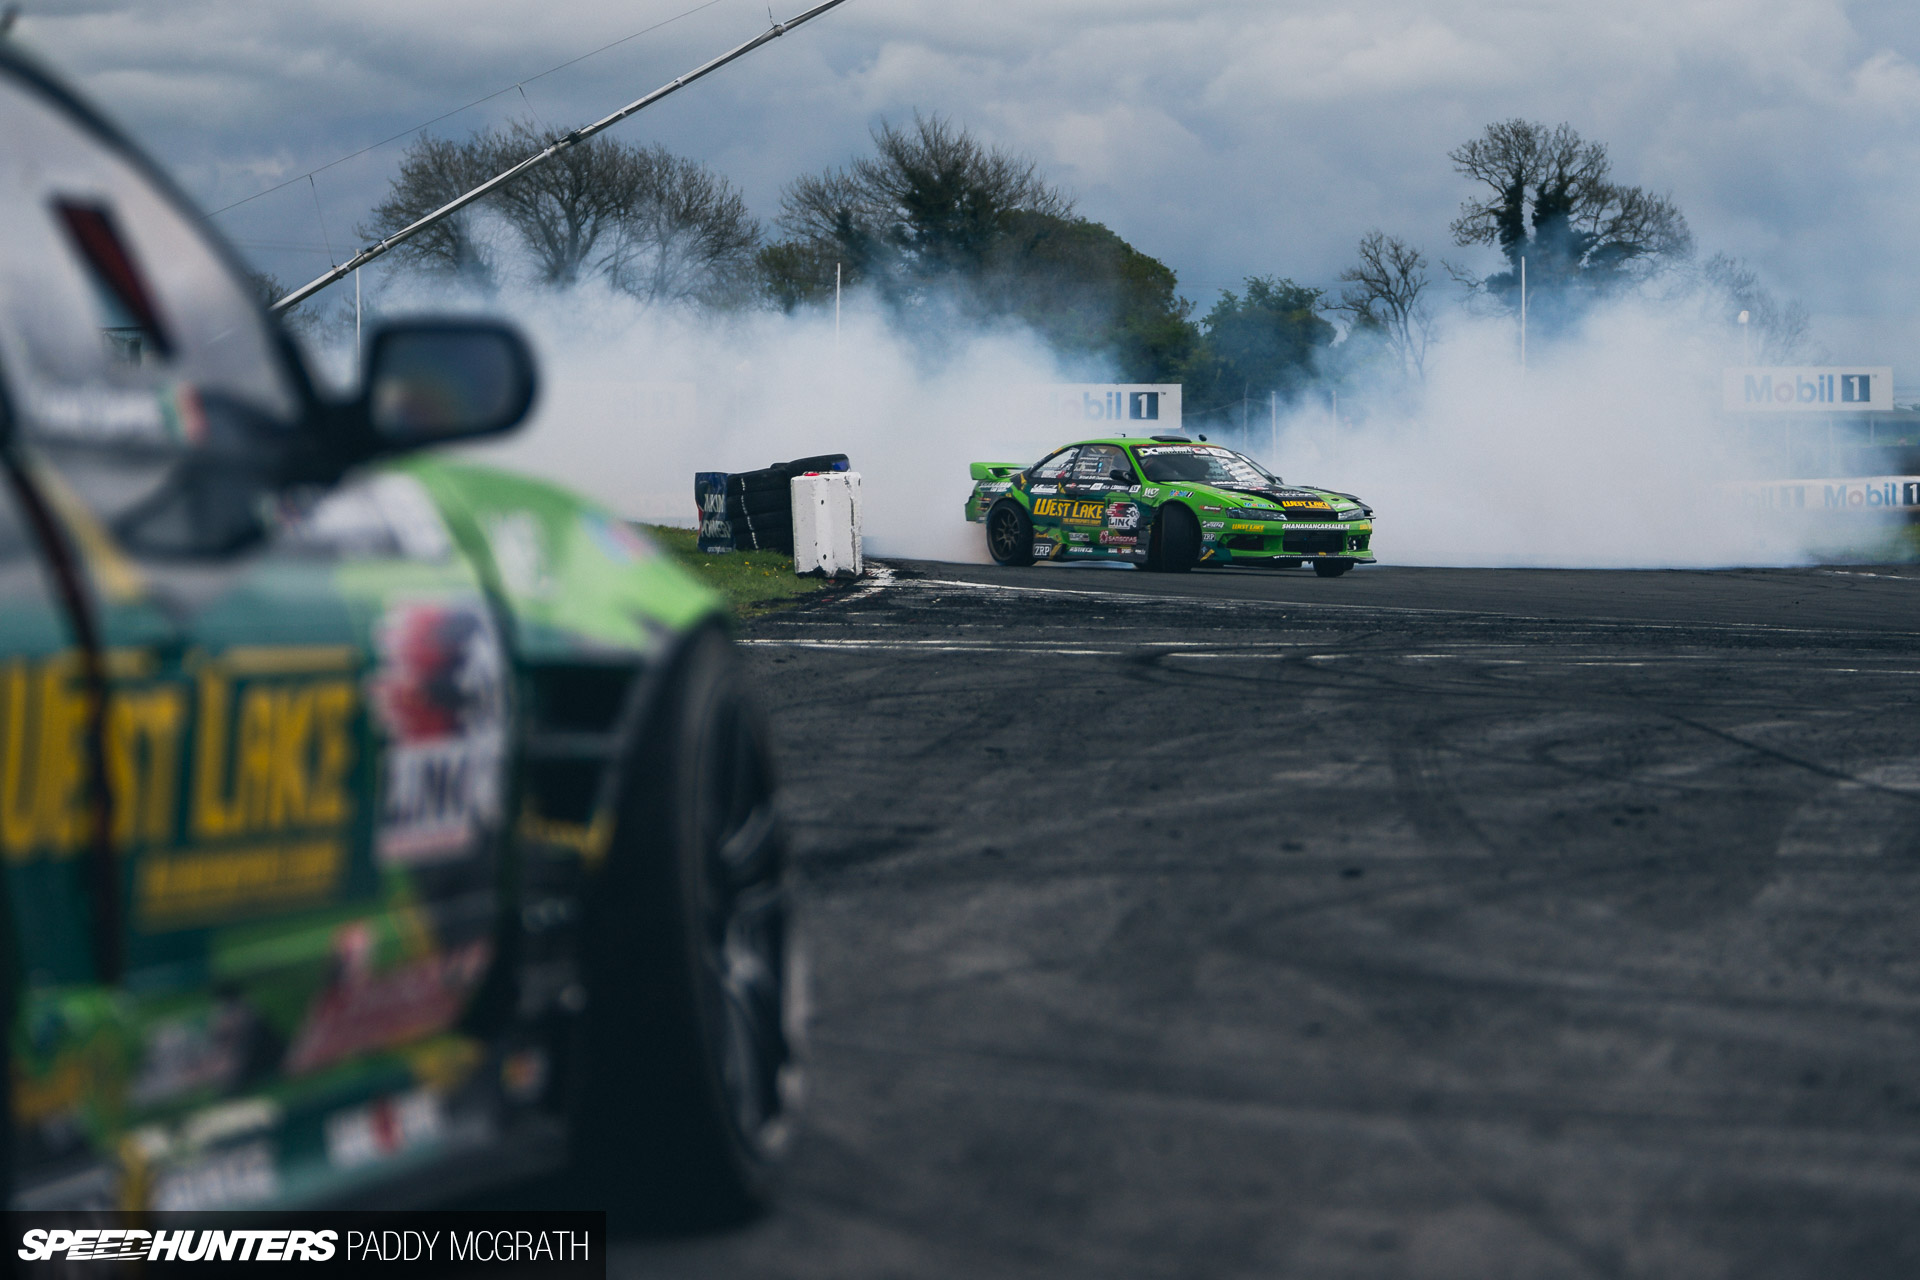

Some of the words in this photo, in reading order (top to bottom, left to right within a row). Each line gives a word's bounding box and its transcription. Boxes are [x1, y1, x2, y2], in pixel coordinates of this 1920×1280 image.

[1744, 374, 1835, 403] Mobil
[1823, 483, 1897, 508] Mobil
[1033, 498, 1071, 517] WEST
[1072, 501, 1104, 519] LAKE
[1109, 518, 1130, 527] LINK
[1034, 546, 1050, 556] ZRP
[190, 662, 360, 842] LAKE
